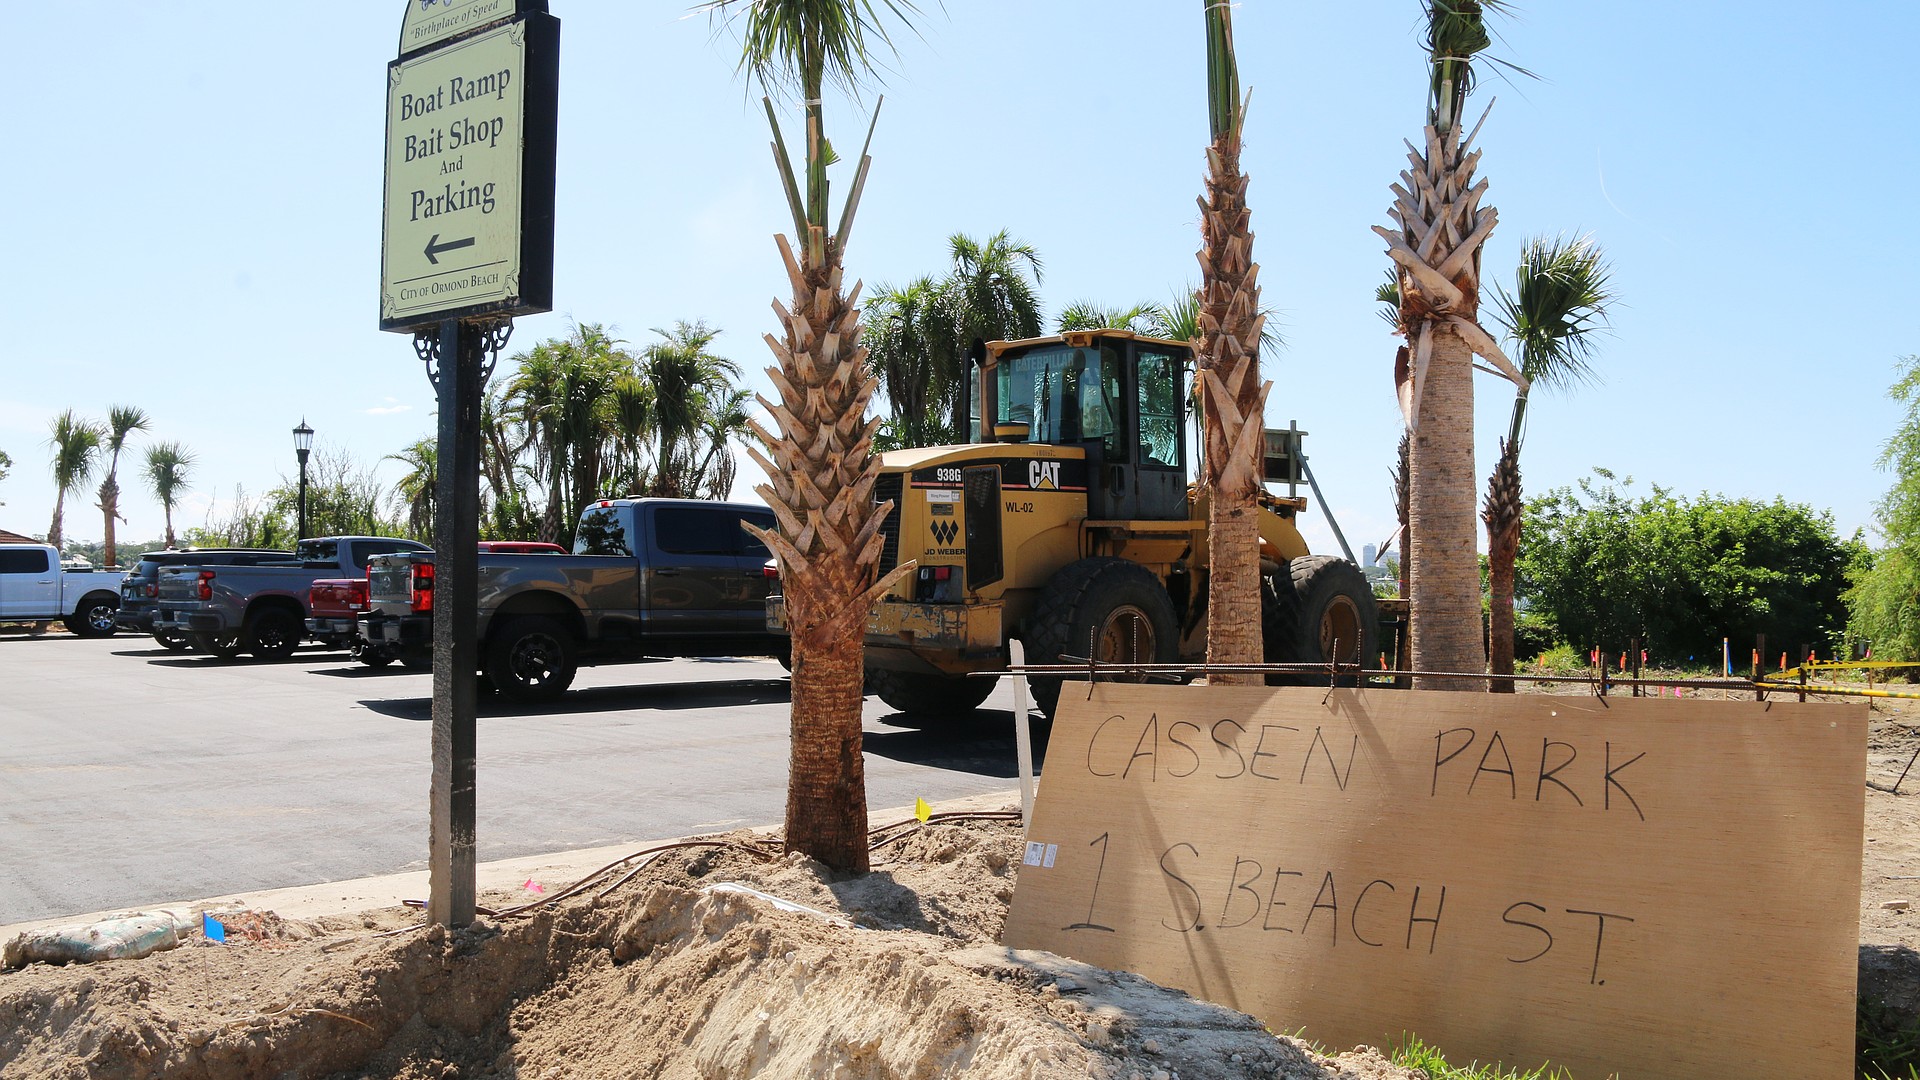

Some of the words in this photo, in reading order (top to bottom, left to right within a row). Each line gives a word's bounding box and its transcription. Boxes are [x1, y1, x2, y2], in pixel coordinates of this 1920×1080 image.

[461, 8, 472, 24] of
[401, 86, 444, 121] Boat
[449, 68, 511, 106] Ramp
[404, 128, 444, 163] Bait
[449, 116, 504, 149] Shop
[439, 155, 463, 175] And
[410, 180, 496, 222] Parking
[400, 288, 418, 301] CITY
[419, 286, 430, 297] OF
[431, 282, 469, 294] ORMOND
[471, 273, 499, 287] BEACH
[1015, 352, 1074, 372] CATERPILLAR
[936, 468, 962, 482] 938G
[1028, 460, 1061, 490] CAT
[1005, 502, 1034, 513] WL-02
[1087, 712, 1358, 792] CASSEN
[1431, 727, 1646, 822] PARK
[1061, 831, 1115, 932] 1
[1502, 901, 1635, 985] ST.
